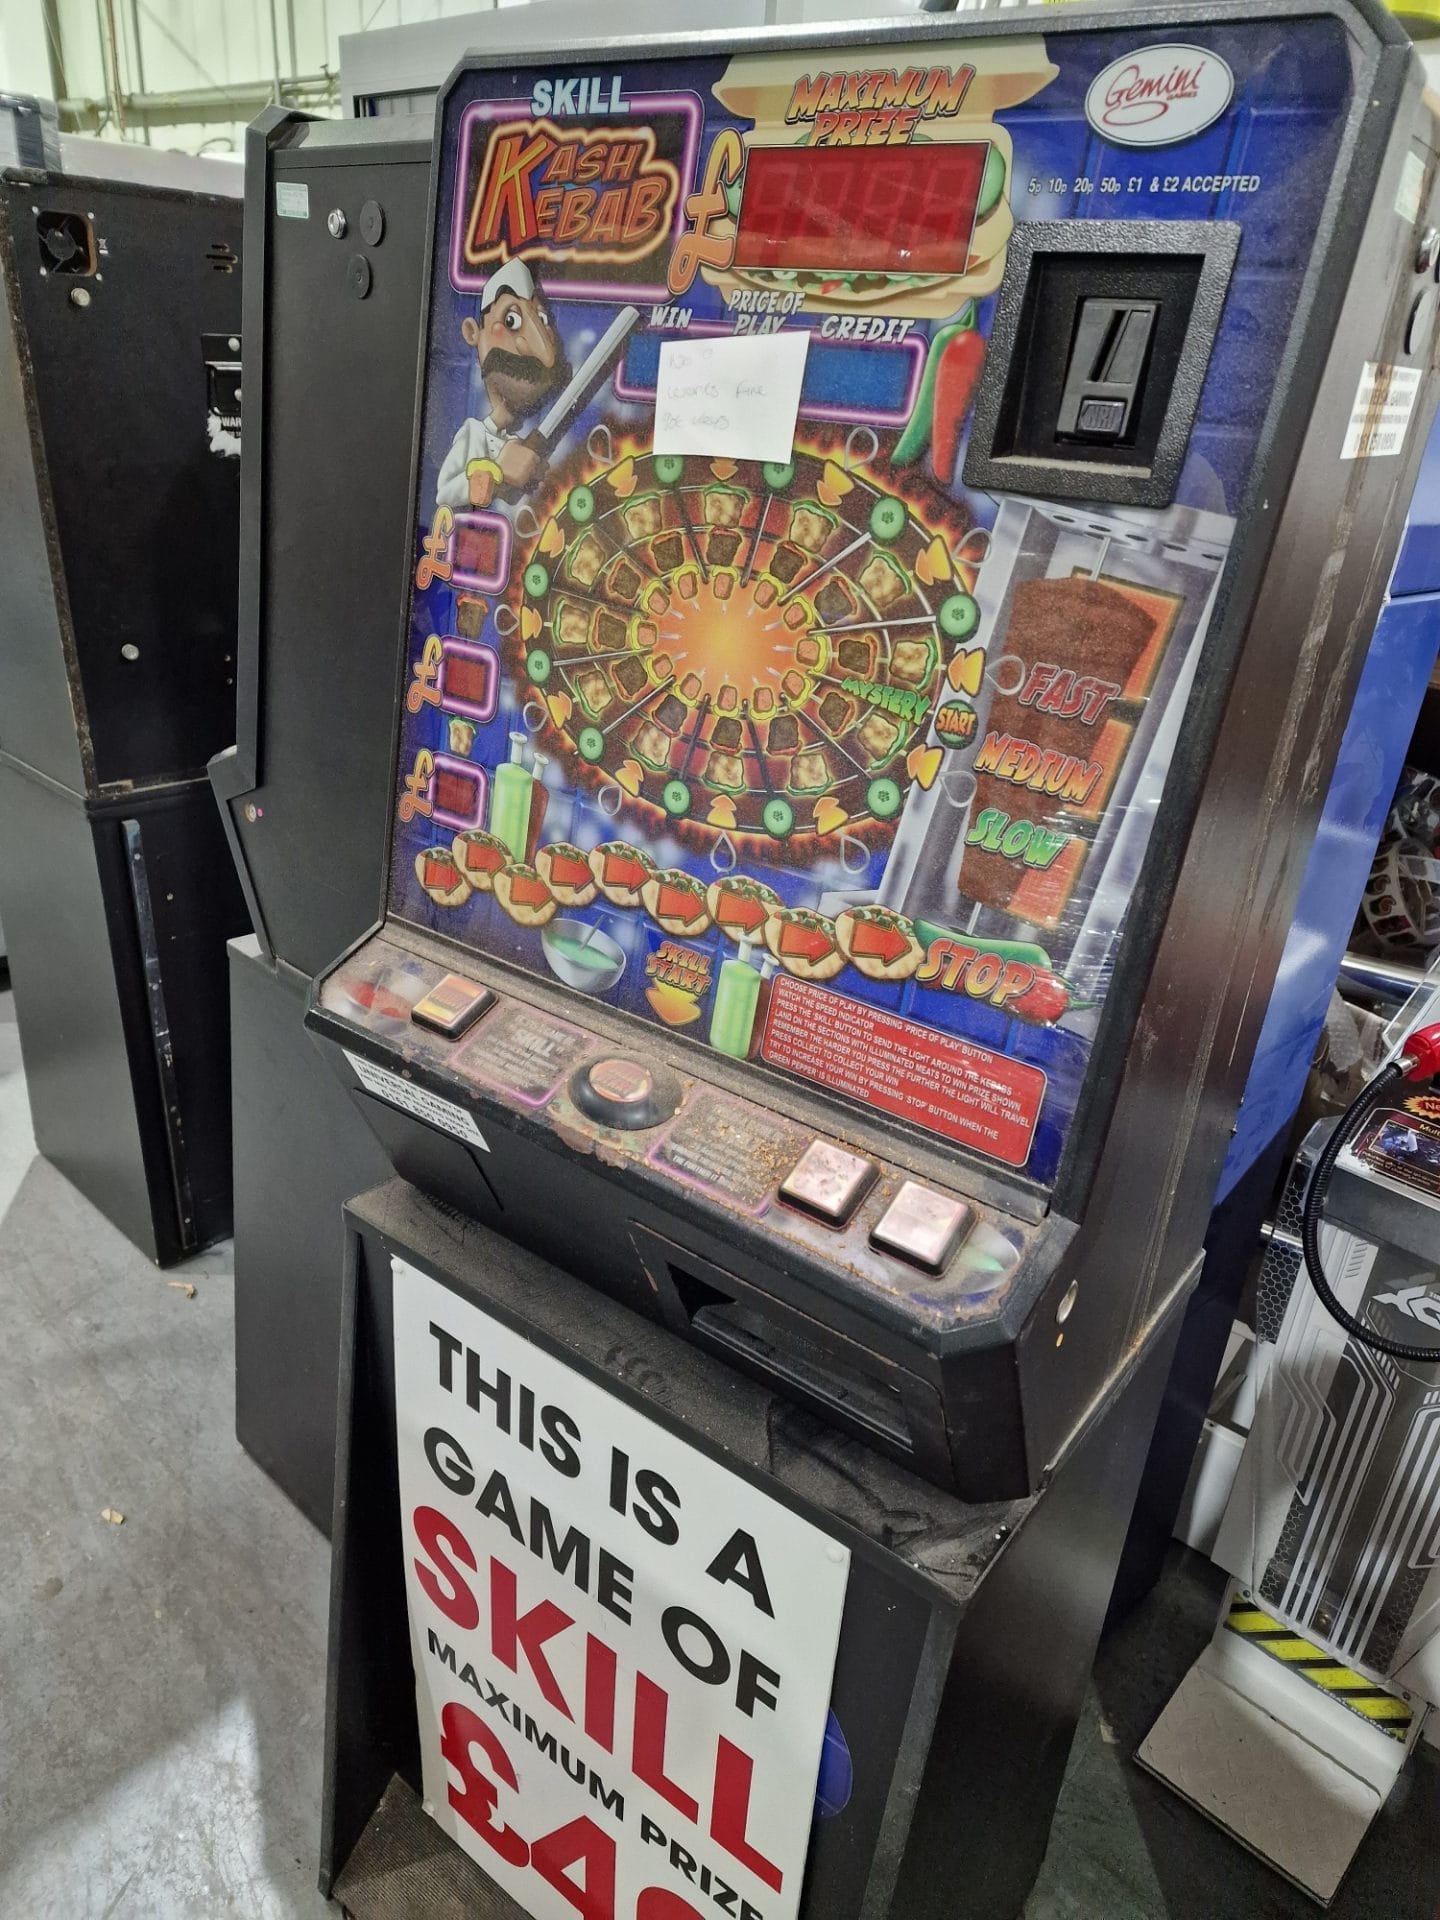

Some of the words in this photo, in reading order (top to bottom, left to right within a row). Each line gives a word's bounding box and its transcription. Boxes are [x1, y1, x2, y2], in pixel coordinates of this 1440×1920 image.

[530, 75, 631, 117] SKILL
[785, 64, 976, 125] MAXIMUM
[1104, 61, 1206, 108] Gemini
[807, 108, 922, 147] PRIZE
[1028, 177, 1041, 195] 5p
[1049, 178, 1067, 195] 10p
[1073, 178, 1094, 195] 20p
[1100, 178, 1121, 194] 50p
[1127, 177, 1142, 192] £1
[1150, 177, 1160, 192] &
[1162, 176, 1178, 192] £2
[1181, 175, 1260, 192] ACCEPTED
[651, 306, 692, 329] WIN
[728, 290, 778, 314] PRICE
[781, 291, 806, 315] OF
[733, 314, 786, 336] PLAY
[821, 315, 915, 344] CREDIT
[840, 677, 932, 727] MYSTERY
[936, 707, 976, 737] START
[1018, 661, 1121, 726] FAST
[973, 731, 1103, 805] MEDIUM
[964, 807, 1069, 870] SLOW
[645, 952, 713, 997] START
[655, 940, 712, 976] SKILL
[916, 938, 1037, 1007] STOP
[777, 988, 801, 1003] WATCH
[802, 997, 814, 1008] THE
[815, 1002, 837, 1016] SPEED
[837, 1010, 874, 1030] INDICATOR
[780, 978, 806, 994] CHOOSE
[807, 988, 827, 1002] PRICE
[828, 996, 837, 1005] OF
[839, 999, 856, 1012] PLAY
[856, 1006, 867, 1016] BY
[868, 1010, 902, 1030] PRESSING
[928, 1033, 938, 1043] OF
[961, 1045, 992, 1063] BUTTON
[771, 1029, 791, 1043] PRESS
[792, 1037, 822, 1055] COLLECT
[823, 1050, 832, 1060] TO
[833, 1054, 863, 1072] COLLECT
[864, 1066, 884, 1080] YOUR
[885, 1074, 899, 1086] WIN
[774, 1009, 791, 1021] LAND
[792, 1016, 802, 1025] ON
[803, 1020, 817, 1031] THE
[817, 1025, 850, 1044] SECTIONS
[850, 1038, 868, 1051] WITH
[869, 1045, 914, 1069] ILLUMINATED
[915, 1063, 939, 1079] MEATS
[940, 1073, 951, 1084] TO
[951, 1078, 967, 1090] WIN
[968, 1084, 990, 1099] PRIZE
[991, 1093, 1020, 1111] SHOWN
[776, 998, 797, 1012] PRESS
[798, 1007, 811, 1018] THE
[834, 1021, 861, 1037] BUTTON
[862, 1031, 872, 1041] TO
[873, 1036, 892, 1049] SEND
[894, 1044, 908, 1055] THE
[908, 1049, 929, 1063] LIGHT
[931, 1058, 962, 1076] AROUND
[964, 1070, 979, 1083] THE
[768, 1039, 781, 1050] TRY
[782, 1044, 791, 1054] TO
[791, 1048, 824, 1067] INCREASE
[825, 1062, 844, 1076] YOUR
[844, 1070, 857, 1081] WIN
[858, 1075, 868, 1086] BY
[869, 1080, 904, 1100] PRESSING
[927, 1104, 958, 1122] BUTTON
[959, 1116, 981, 1132] WHEN
[983, 1126, 998, 1139] THE
[772, 1019, 807, 1038] REMEMBER
[809, 1033, 822, 1044] THE
[823, 1039, 850, 1055] HARDER
[851, 1050, 866, 1061] YOU
[867, 1056, 890, 1071] PRESS
[891, 1066, 905, 1077] THE
[905, 1071, 939, 1091] FURTHER
[941, 1085, 955, 1097] THE
[956, 1091, 979, 1106] LIGHT
[979, 1100, 999, 1114] WILL
[1000, 1108, 1031, 1127] TRAVEL
[818, 1071, 825, 1080] IS
[825, 1074, 869, 1098] ILLUMINATED
[429, 1320, 581, 1479] THIS
[609, 1445, 681, 1546] IS
[705, 1528, 775, 1620] A
[423, 1427, 634, 1627] GAME
[661, 1605, 781, 1719] OF
[413, 1506, 783, 1894] SKILL
[427, 1628, 624, 1822] MAXIMUM
[441, 1702, 706, 1920] £4
